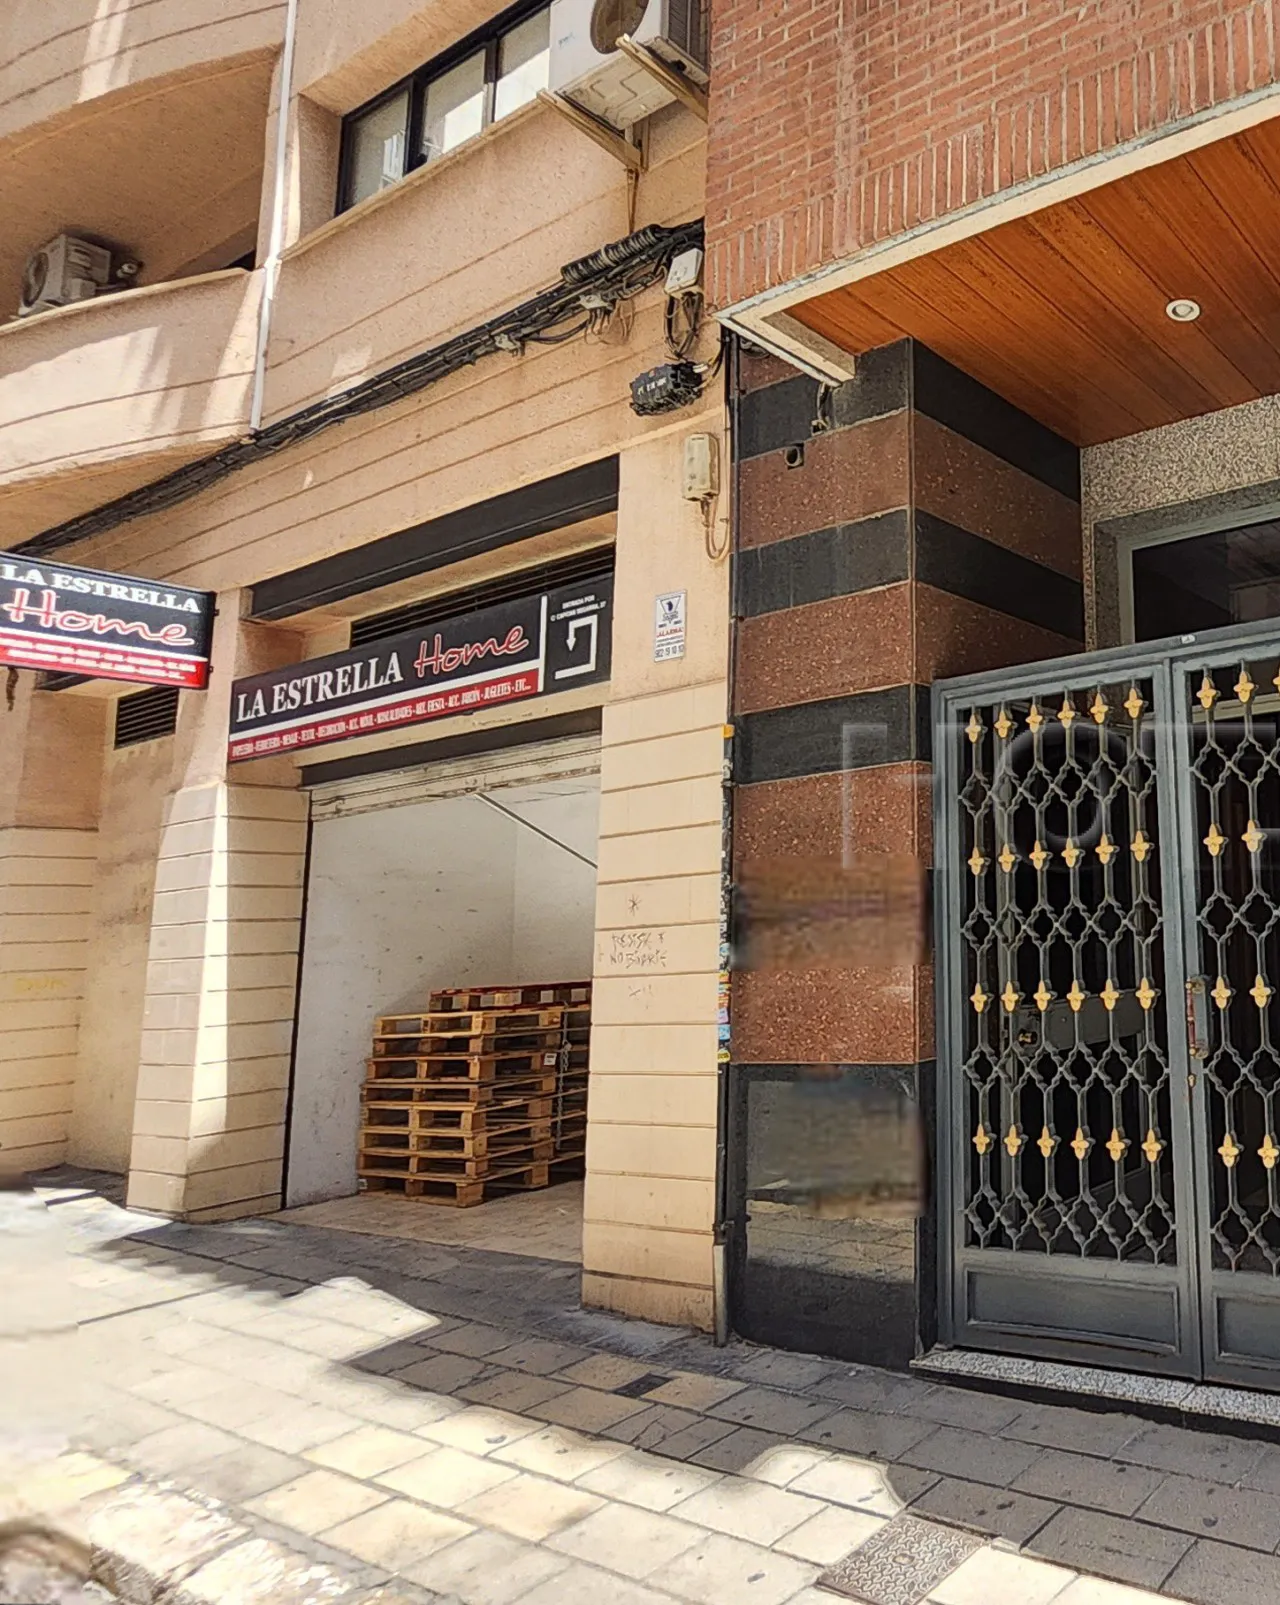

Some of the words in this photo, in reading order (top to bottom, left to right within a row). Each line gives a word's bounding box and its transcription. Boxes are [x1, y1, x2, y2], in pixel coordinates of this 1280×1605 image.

[1, 564, 48, 586] LA
[51, 573, 202, 613] ESTRELLA
[1, 587, 196, 647] Home
[236, 688, 267, 723] LA
[270, 651, 404, 714] ESTRELLA
[413, 624, 530, 678] Home
